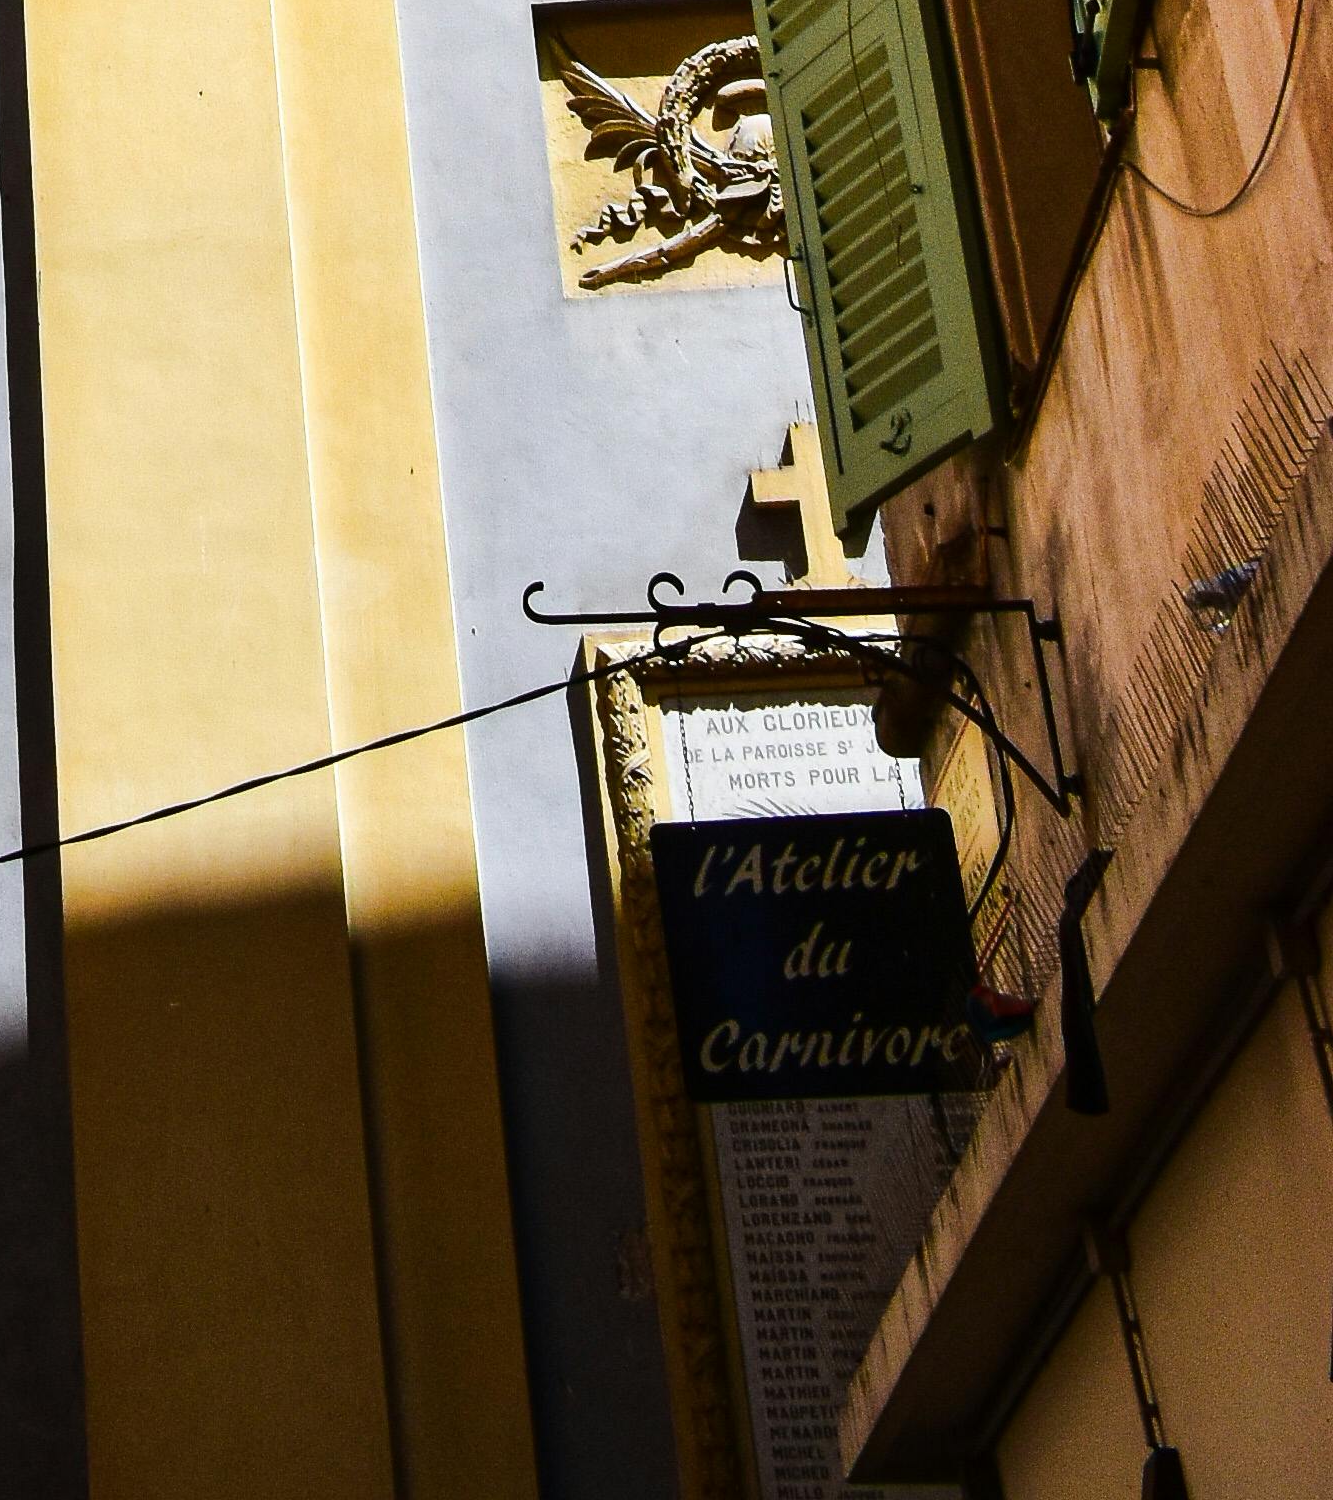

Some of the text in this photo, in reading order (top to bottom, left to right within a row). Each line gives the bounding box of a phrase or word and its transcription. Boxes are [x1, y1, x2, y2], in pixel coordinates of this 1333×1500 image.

[707, 706, 876, 735] AUX GLORIEUX
[712, 747, 734, 763] LA
[743, 742, 827, 760] PAROISSE
[729, 771, 795, 791] MORTS
[810, 767, 860, 785] POUR
[694, 836, 923, 897] l'Atelier
[784, 921, 852, 980] du
